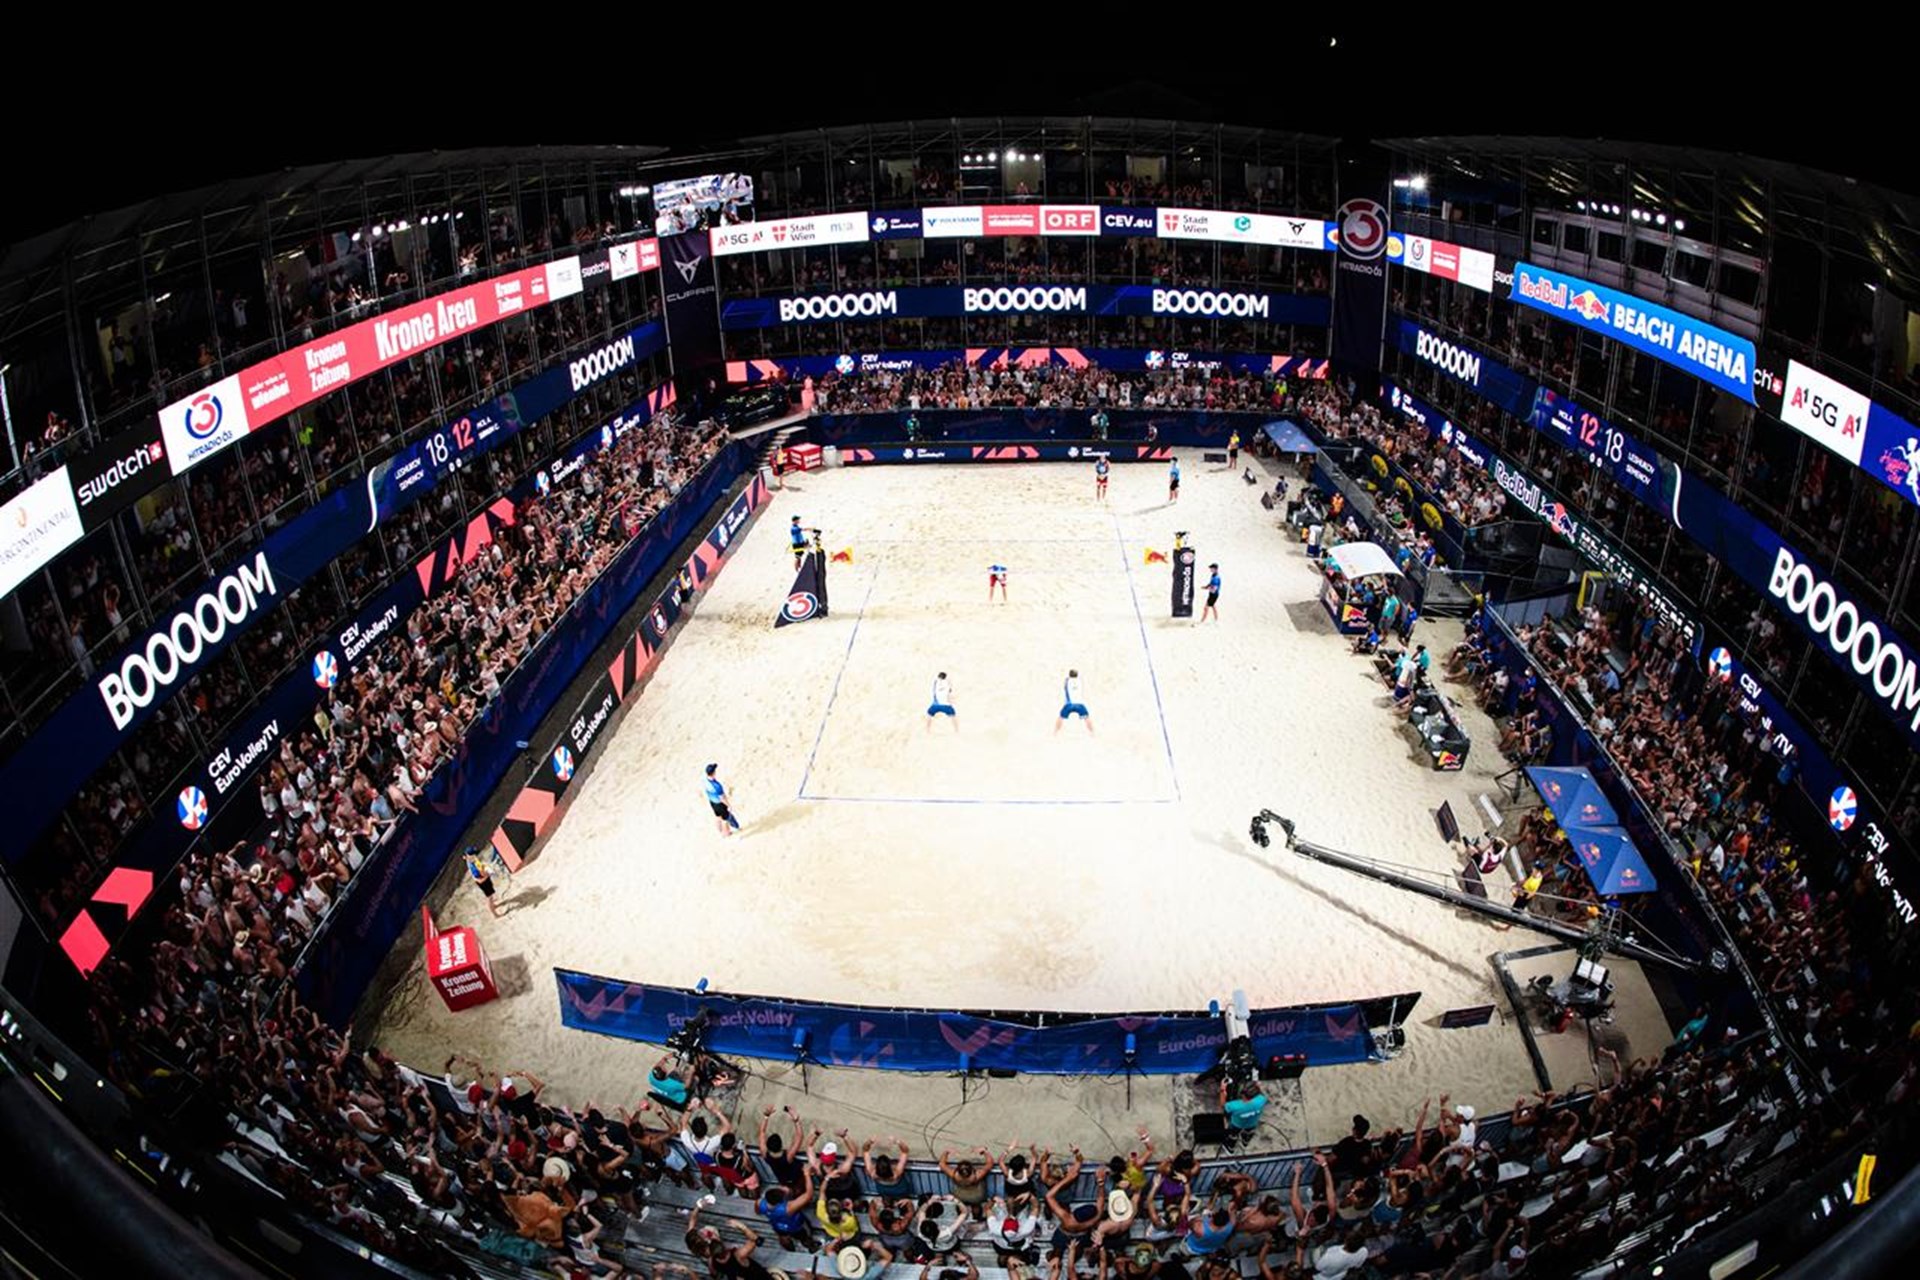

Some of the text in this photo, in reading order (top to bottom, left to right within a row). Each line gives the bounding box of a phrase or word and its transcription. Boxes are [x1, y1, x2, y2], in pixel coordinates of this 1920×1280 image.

[790, 223, 815, 232] Stadt
[1048, 213, 1093, 226] ORF
[1105, 214, 1153, 228] CEV.eu
[1183, 215, 1208, 224] Stadt
[1183, 224, 1208, 234] Wien
[731, 234, 748, 245] 5G
[791, 233, 815, 242] Wien
[667, 286, 714, 302] CUPRA
[779, 291, 897, 321] BOOOOOM
[964, 287, 1086, 312] BOOOOOM
[1152, 289, 1269, 318] BOOOOOM
[374, 319, 436, 361] Krone
[1613, 303, 1675, 349] BEACH
[1677, 331, 1747, 384] ARENA
[305, 340, 347, 371] Kronen
[569, 335, 635, 392] BOOOOOM
[1416, 329, 1480, 386] BOOOOOM
[309, 361, 350, 392] Zeitung
[1811, 395, 1838, 427] 5G
[188, 437, 221, 461] HITRADIO
[425, 418, 474, 467] 18 12
[1579, 412, 1599, 447] 12
[1605, 428, 1624, 462] 18
[78, 446, 151, 506] swatch
[98, 551, 277, 731] BOOOOOM
[340, 622, 359, 649] CEV
[344, 605, 398, 662] EuroVolleyTV
[1740, 673, 1762, 699] CEV
[571, 715, 586, 740] CEV
[575, 694, 613, 753] EuroVolleyTV
[208, 748, 232, 778] CEV
[214, 720, 279, 794] EuroVolleyTV
[441, 970, 478, 988] Kronen
[447, 981, 485, 997] Zeitung
